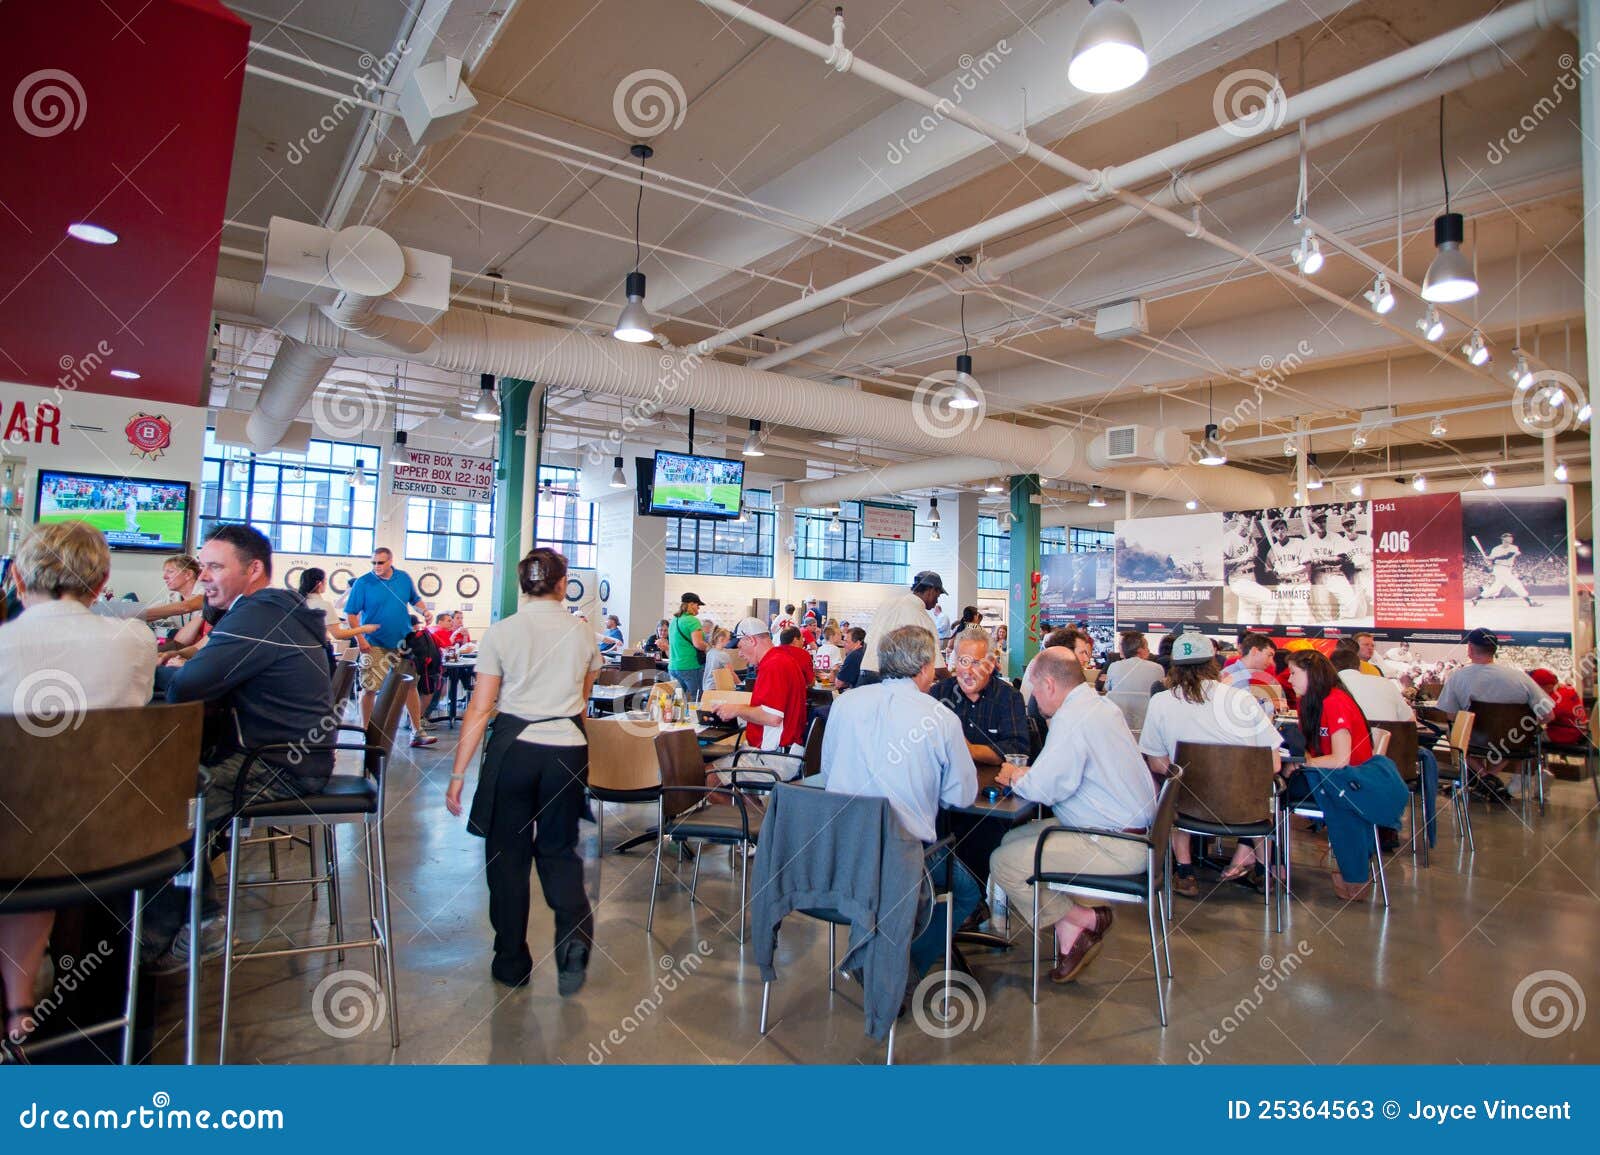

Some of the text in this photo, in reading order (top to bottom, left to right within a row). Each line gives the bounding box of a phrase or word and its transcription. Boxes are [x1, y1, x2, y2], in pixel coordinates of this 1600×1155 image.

[0, 400, 61, 446] AR
[434, 456, 453, 467] BOX
[395, 465, 428, 478] UPPER
[432, 469, 451, 480] BOX
[393, 481, 437, 493] RESERVED
[441, 486, 457, 495] SEC
[1375, 503, 1396, 512] 1941
[1375, 530, 1410, 553] .406
[1137, 590, 1156, 600] STATES
[1157, 590, 1180, 600] PLUNGED
[1181, 590, 1196, 600] INTO
[1196, 590, 1210, 600] WAR
[1271, 589, 1311, 600] TEAMMATES
[1183, 642, 1192, 656] B
